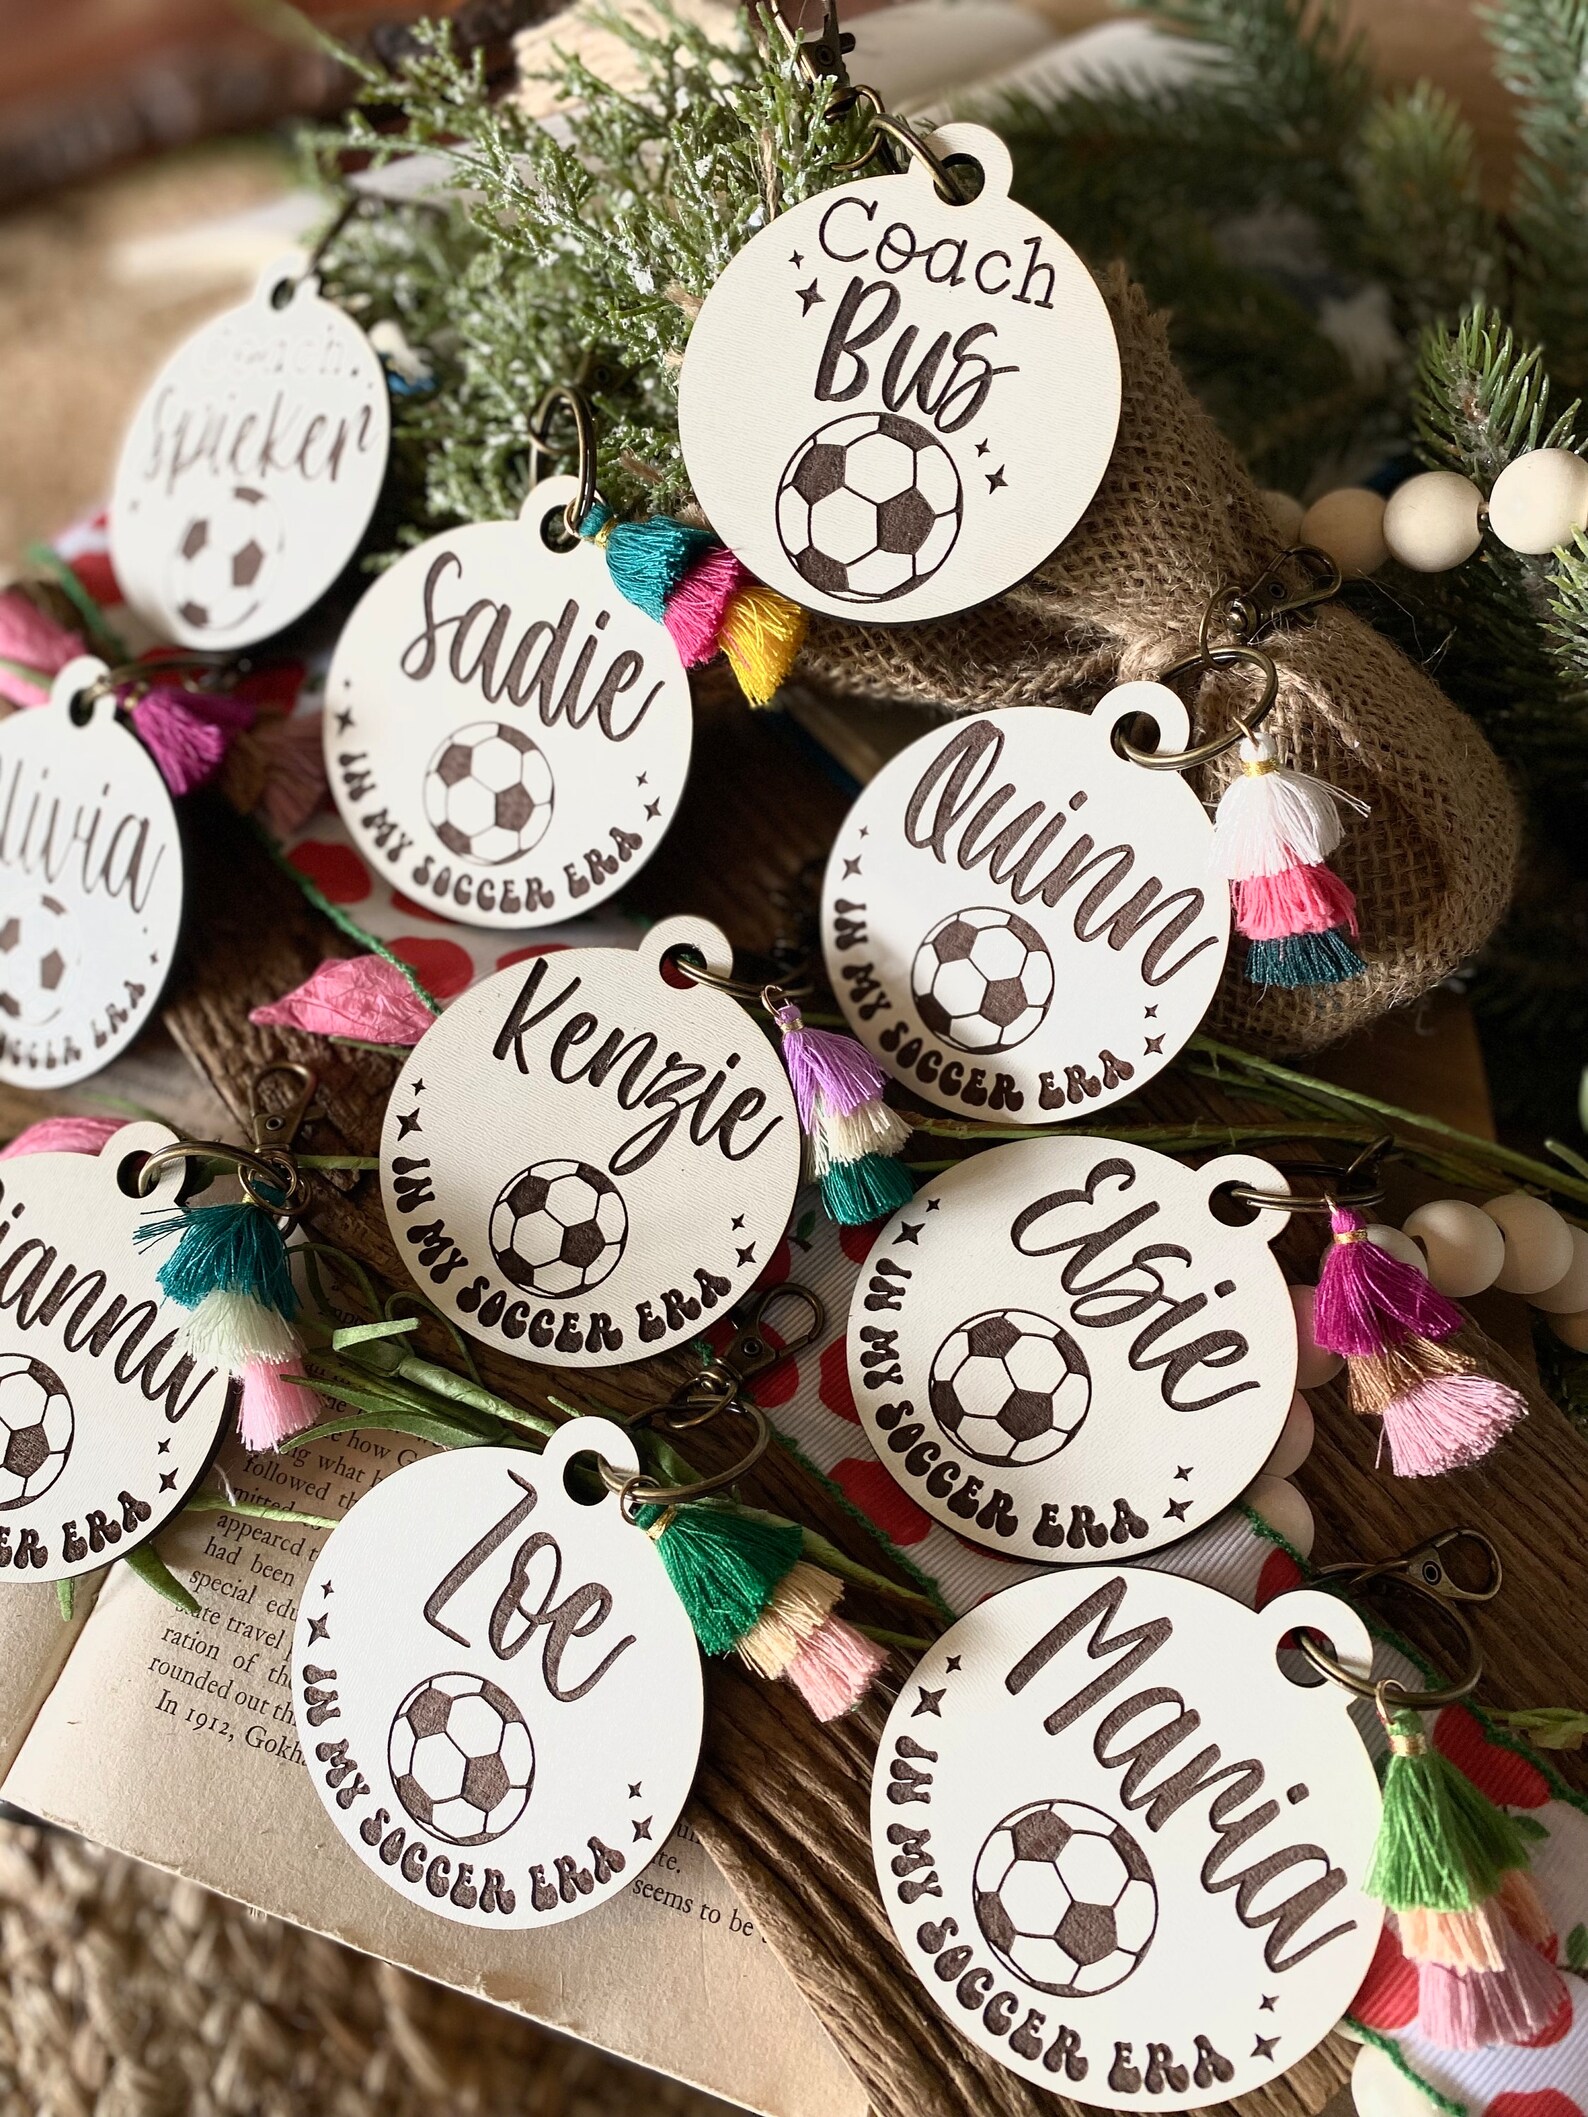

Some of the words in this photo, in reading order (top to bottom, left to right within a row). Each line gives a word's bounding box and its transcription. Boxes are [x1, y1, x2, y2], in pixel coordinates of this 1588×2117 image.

[818, 197, 1055, 309] Coach
[814, 276, 1020, 434] Bus
[144, 385, 375, 495] Spieker
[401, 551, 665, 742] Sadie
[0, 756, 166, 914] livia
[338, 752, 376, 802] IN
[362, 809, 413, 863] MY
[412, 856, 555, 914] SOCCER
[563, 826, 643, 898] ERA
[904, 719, 1219, 986] Quinn
[834, 897, 868, 951] IN
[842, 963, 892, 1021] MY
[0, 1033, 82, 1070] CCER
[493, 957, 784, 1176] Kenzie
[878, 1020, 1025, 1111] SOCCER
[1038, 1049, 1135, 1110] ERA
[391, 1156, 436, 1213] IN
[406, 1219, 468, 1284] MY
[864, 1257, 912, 1312] IN
[1010, 1157, 1261, 1412] Elsie
[0, 1177, 218, 1423] ianna
[455, 1275, 624, 1354] SOCCER
[635, 1267, 732, 1342] ERA
[859, 1325, 904, 1390] MY
[242, 1457, 332, 1501] followed
[318, 1453, 366, 1483] what
[347, 1429, 391, 1459] how
[875, 1400, 1018, 1538] SOCCER
[62, 1490, 152, 1563] ERA
[1032, 1498, 1149, 1549] ERA
[190, 1570, 258, 1605] special
[203, 1537, 243, 1566] had
[250, 1554, 295, 1587] been
[423, 1469, 637, 1702] Zoe
[161, 1628, 220, 1661] ration
[233, 1653, 260, 1673] of
[226, 1616, 286, 1650] travel
[148, 1657, 233, 1700] rounded
[235, 1690, 270, 1715] out
[155, 1688, 178, 1715] In
[185, 1708, 234, 1743] 1912,
[302, 1664, 341, 1727] IN
[315, 1738, 371, 1809] MY
[887, 1735, 938, 1805] IN
[1005, 1576, 1358, 1973] Maria
[359, 1807, 517, 1914] SOCCER
[528, 1835, 627, 1911] ERA
[887, 1823, 944, 1905] MY
[632, 1878, 694, 1914] seems
[700, 1903, 721, 1924] to
[729, 1908, 754, 1937] be
[916, 1917, 1089, 2082] SOCCER
[1107, 2034, 1235, 2095] ERA
